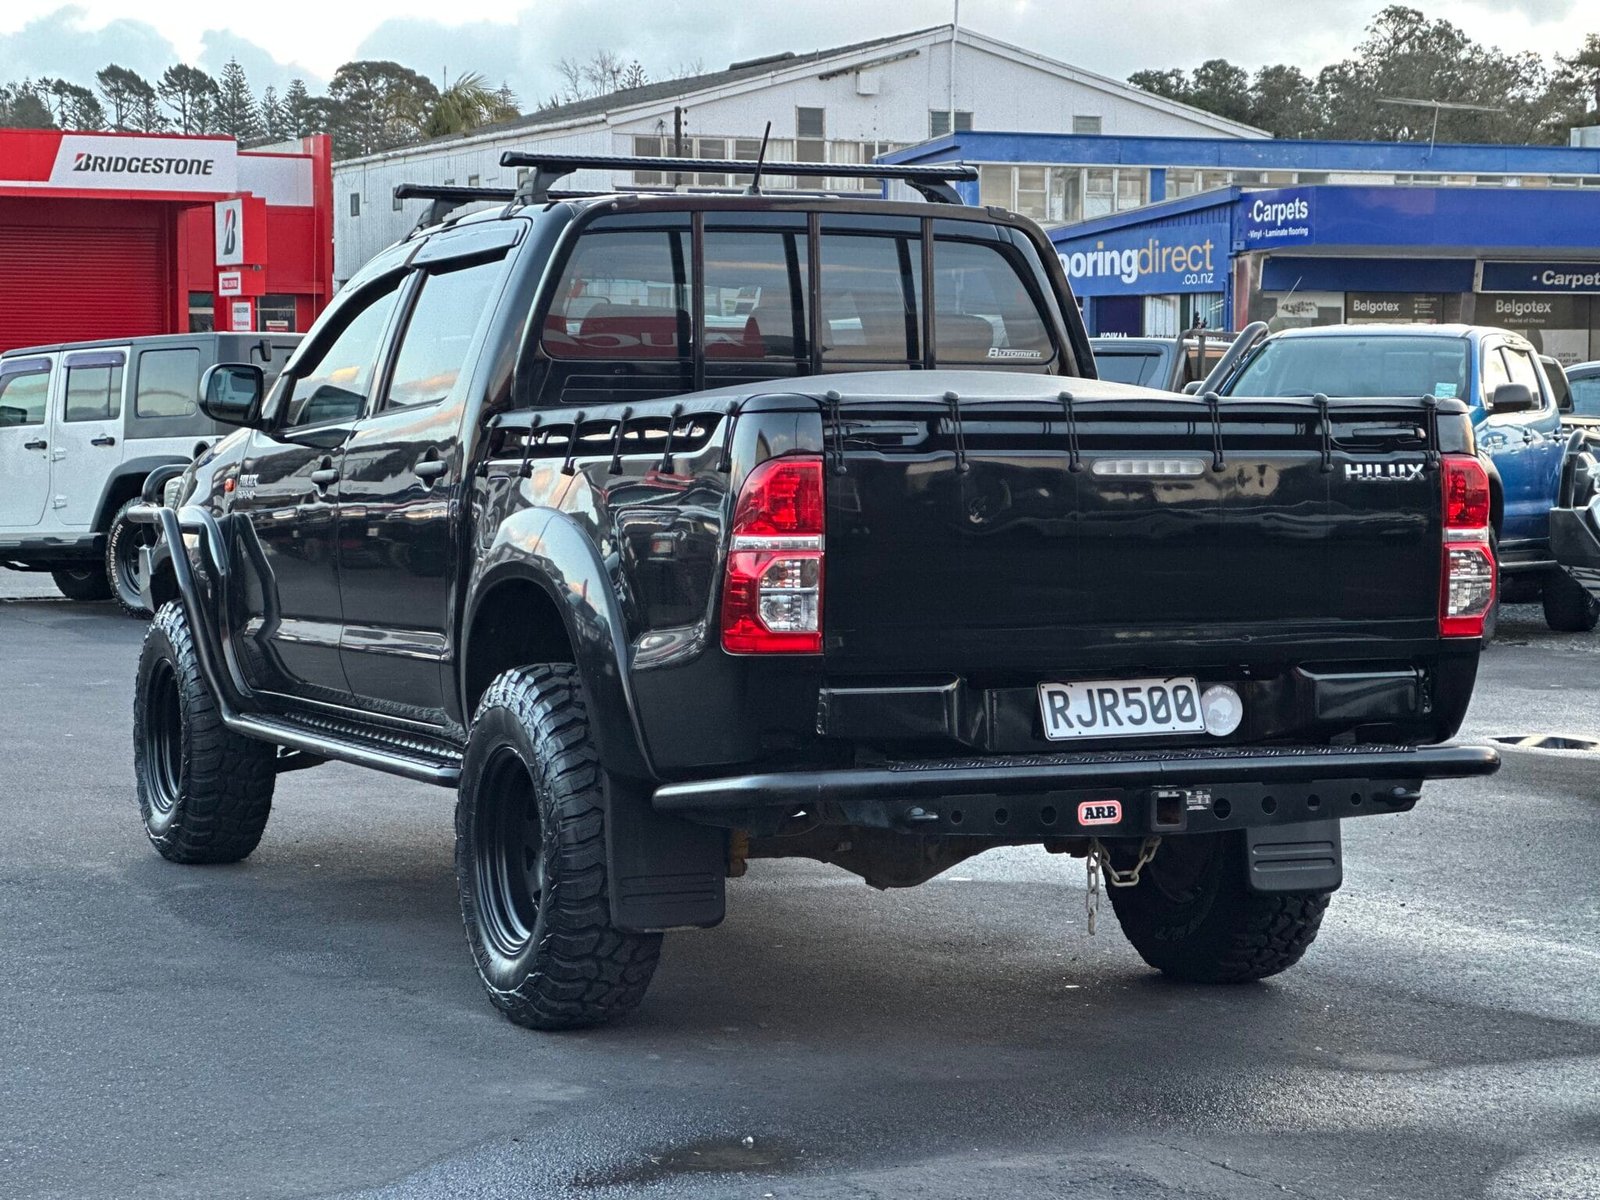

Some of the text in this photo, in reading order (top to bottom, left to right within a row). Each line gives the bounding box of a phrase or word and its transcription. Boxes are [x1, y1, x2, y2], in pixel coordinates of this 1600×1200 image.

[73, 153, 214, 175] BRIDGESTONE
[1253, 197, 1309, 226] Carpets
[1265, 228, 1287, 237] Laminate
[1288, 226, 1308, 236] flooring
[1182, 272, 1214, 285] .co.nz
[1353, 300, 1400, 313] Belgotex
[1495, 299, 1551, 316] Belgotex
[1344, 463, 1425, 481] HILUX
[1047, 684, 1197, 730] RJR500
[1084, 805, 1117, 820] ARB
